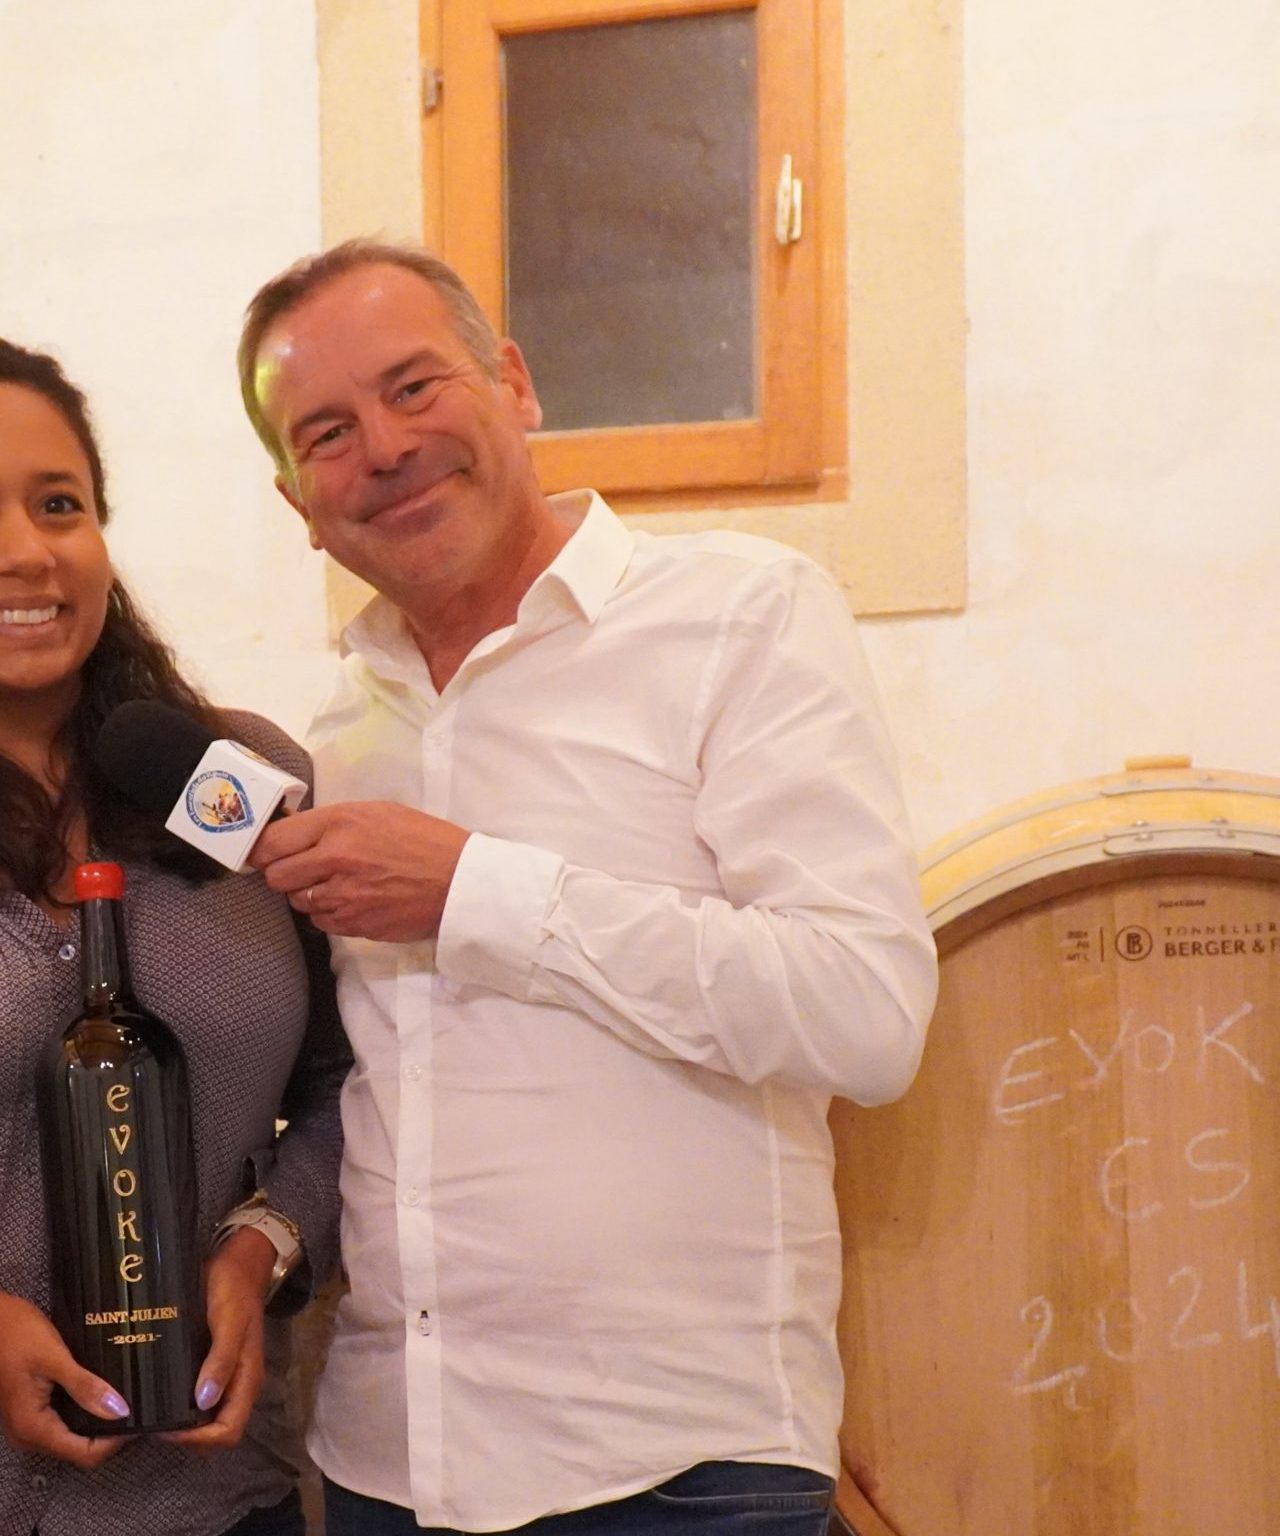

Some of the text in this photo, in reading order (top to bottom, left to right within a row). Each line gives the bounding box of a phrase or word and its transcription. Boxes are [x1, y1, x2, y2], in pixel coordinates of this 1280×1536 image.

[1164, 939, 1247, 957] BERGER
[1251, 938, 1265, 953] &
[106, 1084, 144, 1283] EVOKE
[85, 1306, 178, 1325] SAINT JULIEN
